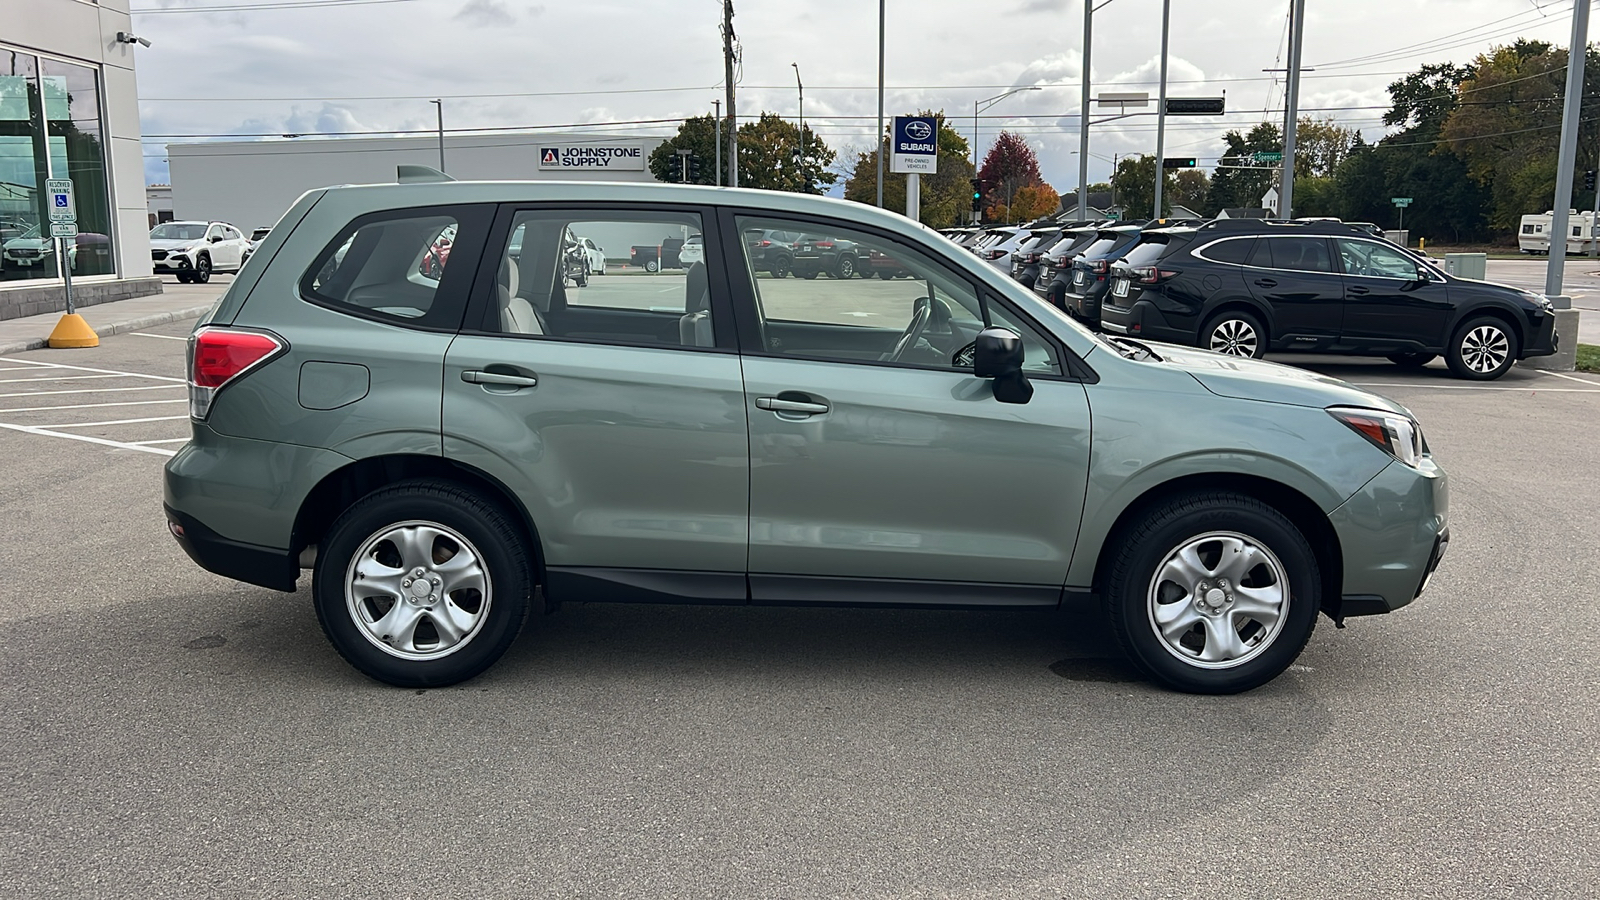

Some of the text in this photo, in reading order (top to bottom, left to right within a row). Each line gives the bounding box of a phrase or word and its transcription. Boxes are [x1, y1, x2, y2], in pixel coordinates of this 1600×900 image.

[900, 142, 934, 152] SUBARU
[561, 147, 641, 158] JOHNSTONE
[562, 157, 611, 167] SUPPLY
